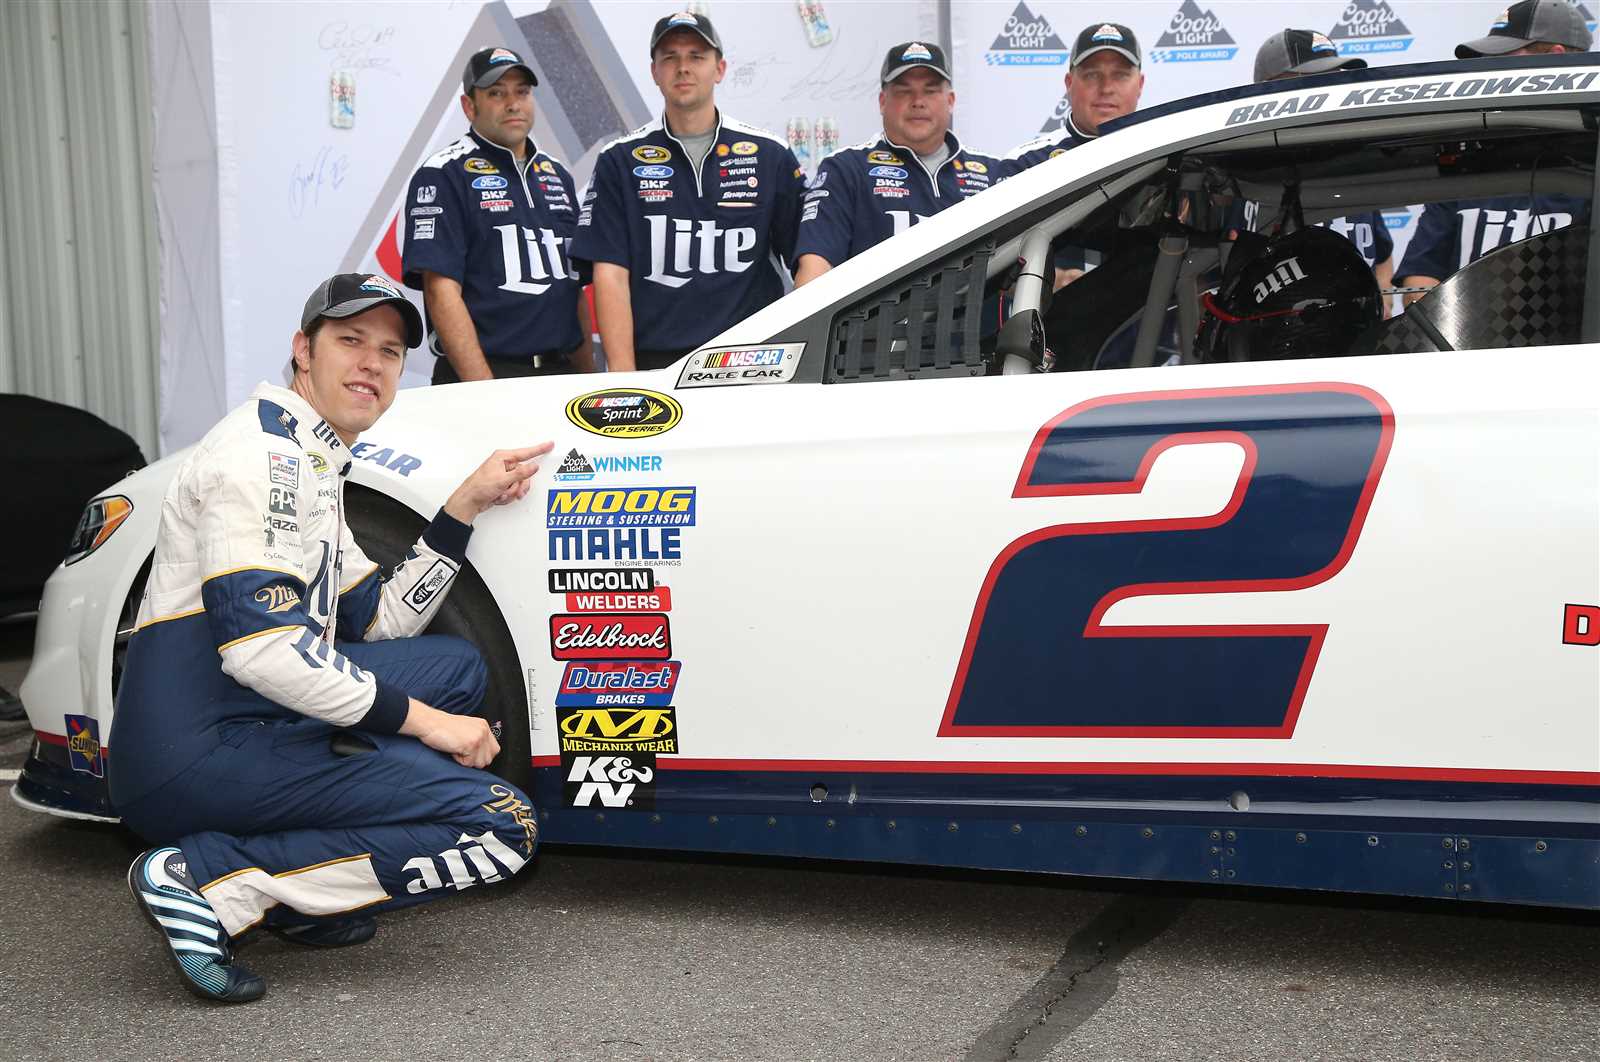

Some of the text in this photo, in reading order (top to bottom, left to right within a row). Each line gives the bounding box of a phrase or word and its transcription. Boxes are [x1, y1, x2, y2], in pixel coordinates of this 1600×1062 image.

[1338, 3, 1398, 26] Coors
[1001, 16, 1056, 37] Coors
[1166, 12, 1224, 34] Coors
[1348, 23, 1388, 36] LIGHT
[1010, 37, 1046, 48] LIGHT
[1176, 32, 1213, 44] LIGHT
[1348, 40, 1404, 52] POLE AWARD
[1010, 55, 1061, 63] POLE AWARD
[1177, 50, 1229, 59] POLE AWARD
[1225, 72, 1600, 126] BRAD KESELOWSKI
[643, 215, 757, 288] Lite
[727, 350, 778, 366] NASCAR
[687, 369, 783, 380] RACE CAR
[601, 396, 641, 407] NASCAR
[602, 408, 643, 422] Sprint
[312, 419, 340, 450] Lite
[626, 425, 664, 433] SERIES
[563, 455, 590, 466] Coors
[593, 456, 662, 472] WINNER
[549, 489, 694, 514] MOOG
[548, 513, 691, 526] STEERING & SUSPENSION
[549, 528, 682, 560] MAHLE
[937, 381, 1396, 739] 2
[554, 572, 649, 591] LINCOLN
[576, 595, 661, 609] WELDERS
[555, 623, 666, 649] Edelbrock
[568, 667, 672, 689] Duralast
[595, 695, 645, 704] BRAKES
[562, 738, 675, 752] MECHANIX WEAR
[168, 864, 186, 878] adidas
